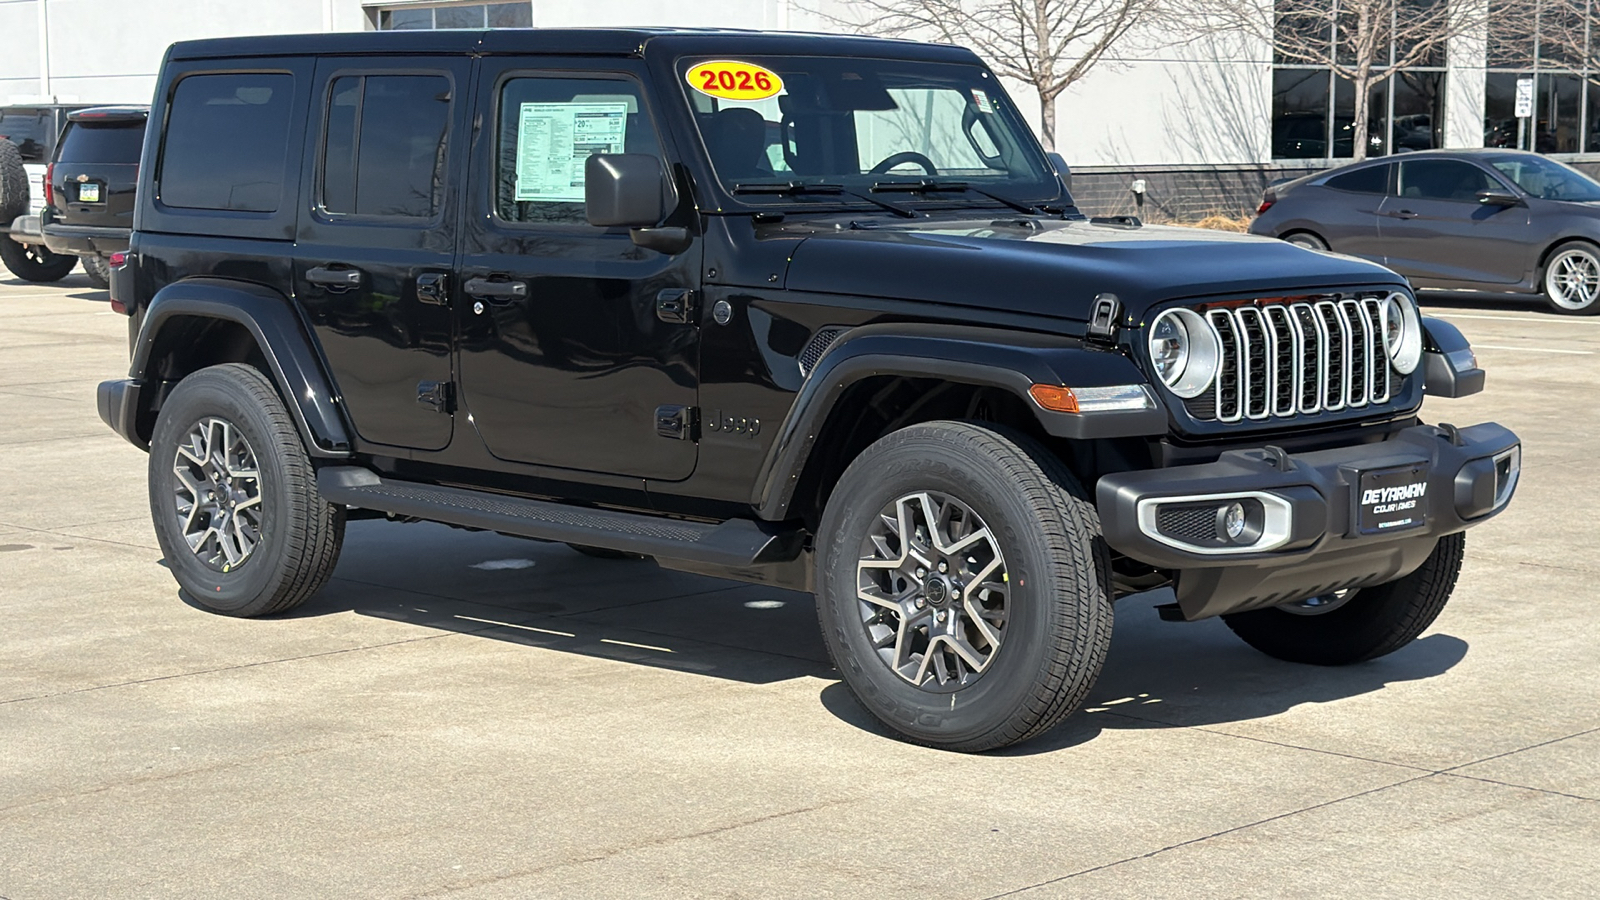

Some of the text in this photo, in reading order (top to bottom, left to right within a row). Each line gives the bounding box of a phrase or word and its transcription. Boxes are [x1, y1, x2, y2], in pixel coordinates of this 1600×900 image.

[699, 70, 772, 91] 2026
[709, 408, 761, 439] Jeep
[1361, 482, 1427, 505] DEYARMAN
